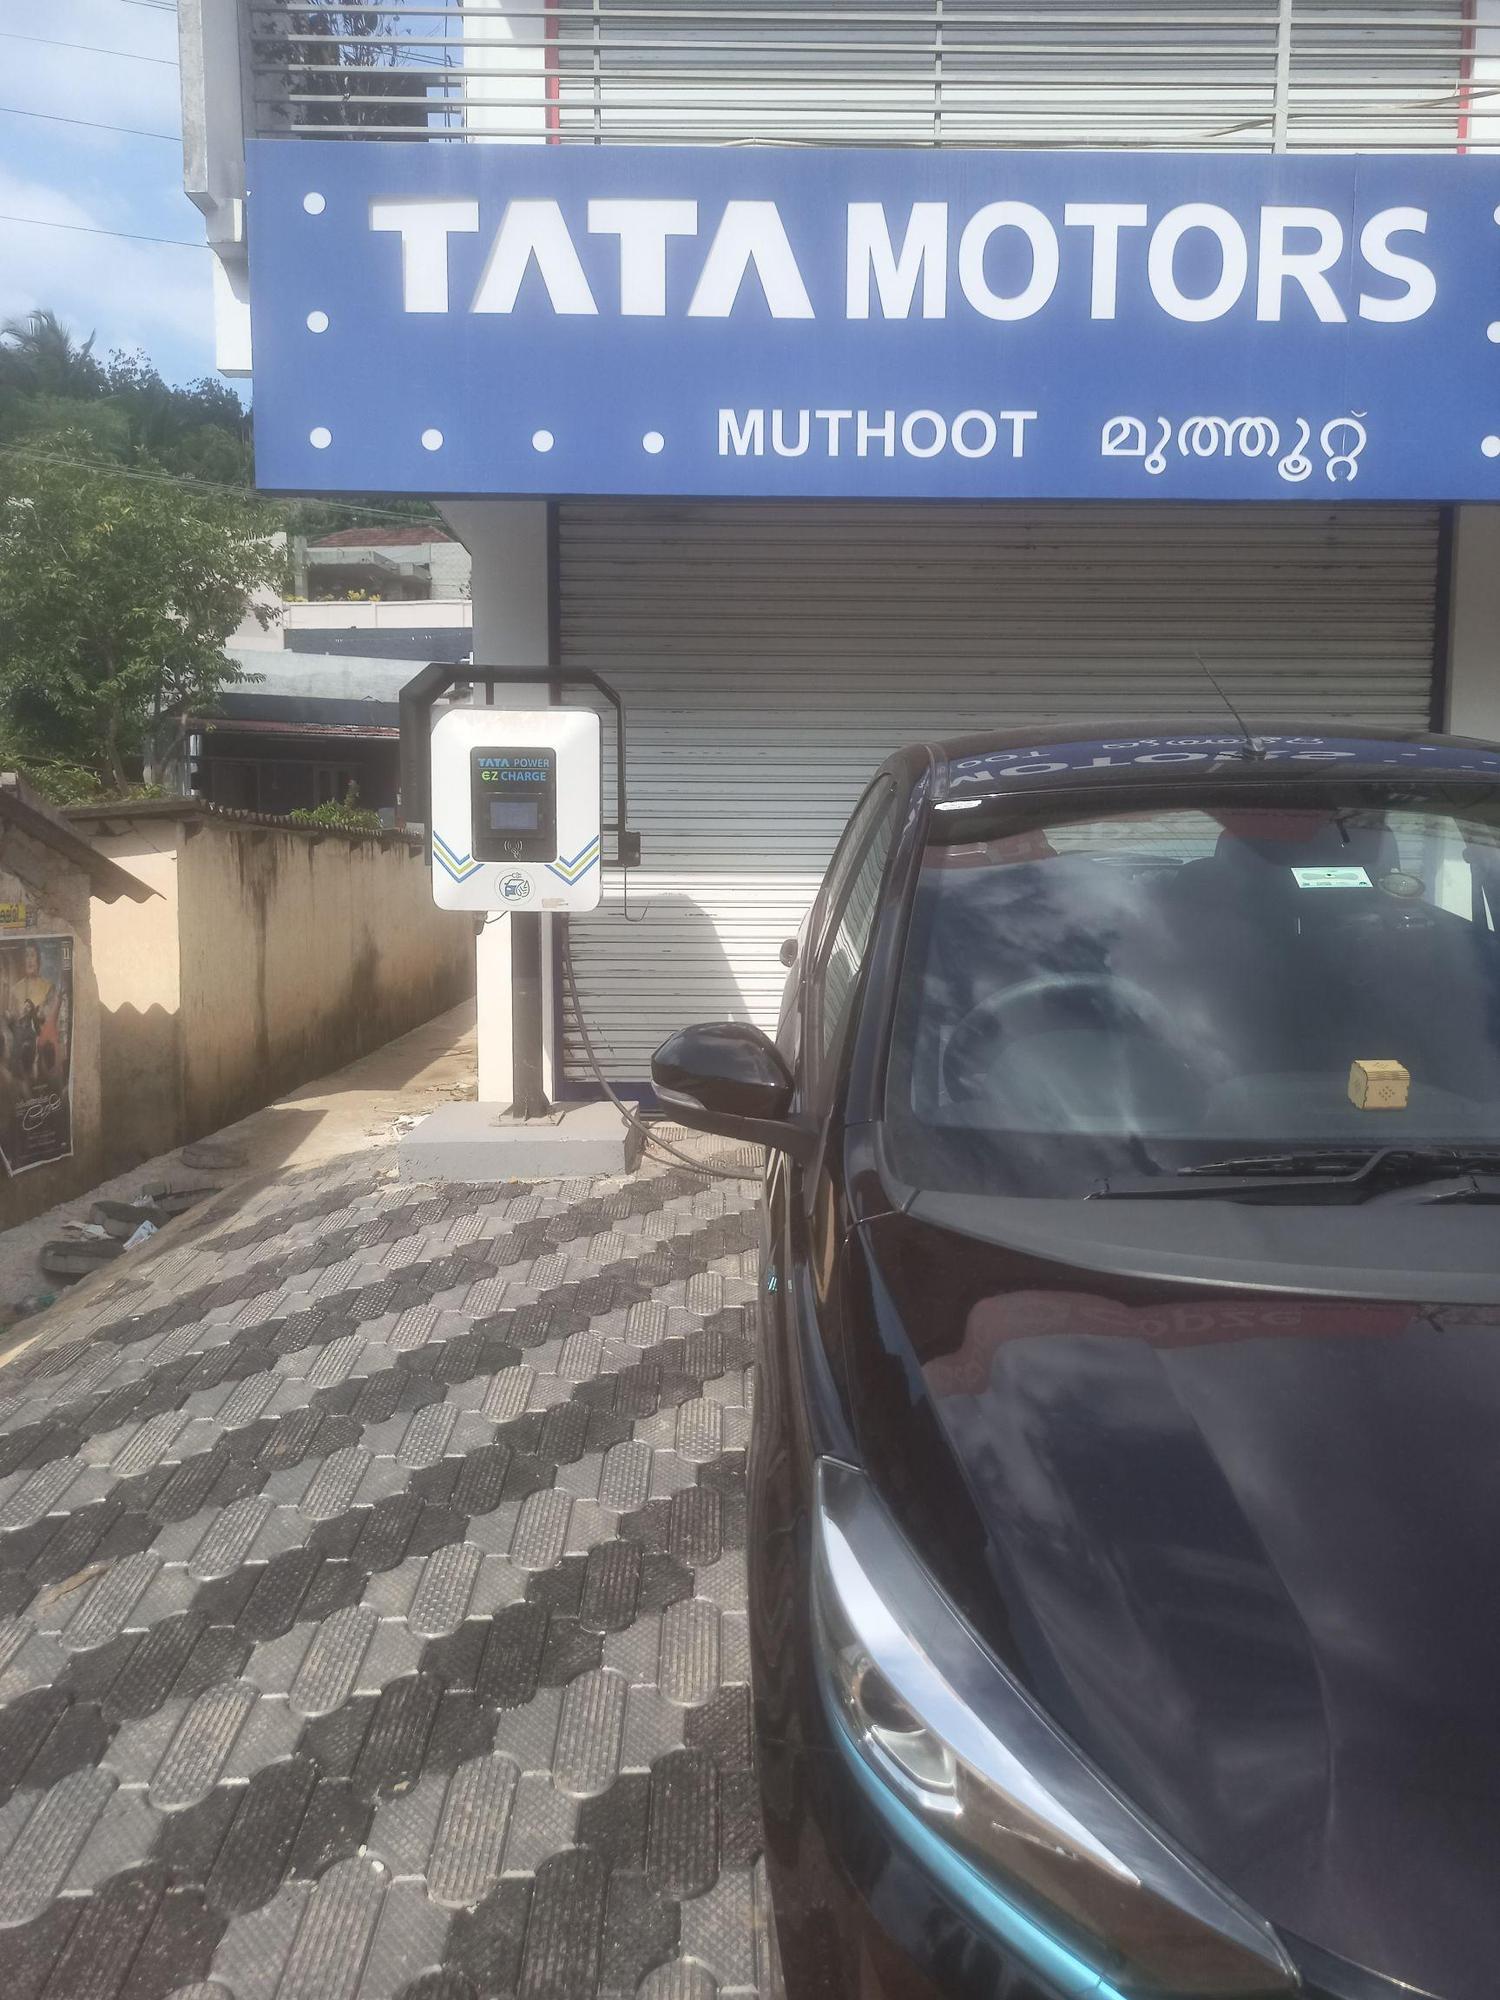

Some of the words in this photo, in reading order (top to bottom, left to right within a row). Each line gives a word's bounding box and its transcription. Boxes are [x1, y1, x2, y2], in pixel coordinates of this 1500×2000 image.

[369, 199, 816, 319] TATA
[845, 200, 1438, 322] MOTORS
[718, 406, 1039, 461] MUTHOOT
[478, 758, 510, 768] TATA
[513, 758, 550, 768] POWER
[481, 770, 499, 781] EZ
[500, 771, 547, 781] CHARGE
